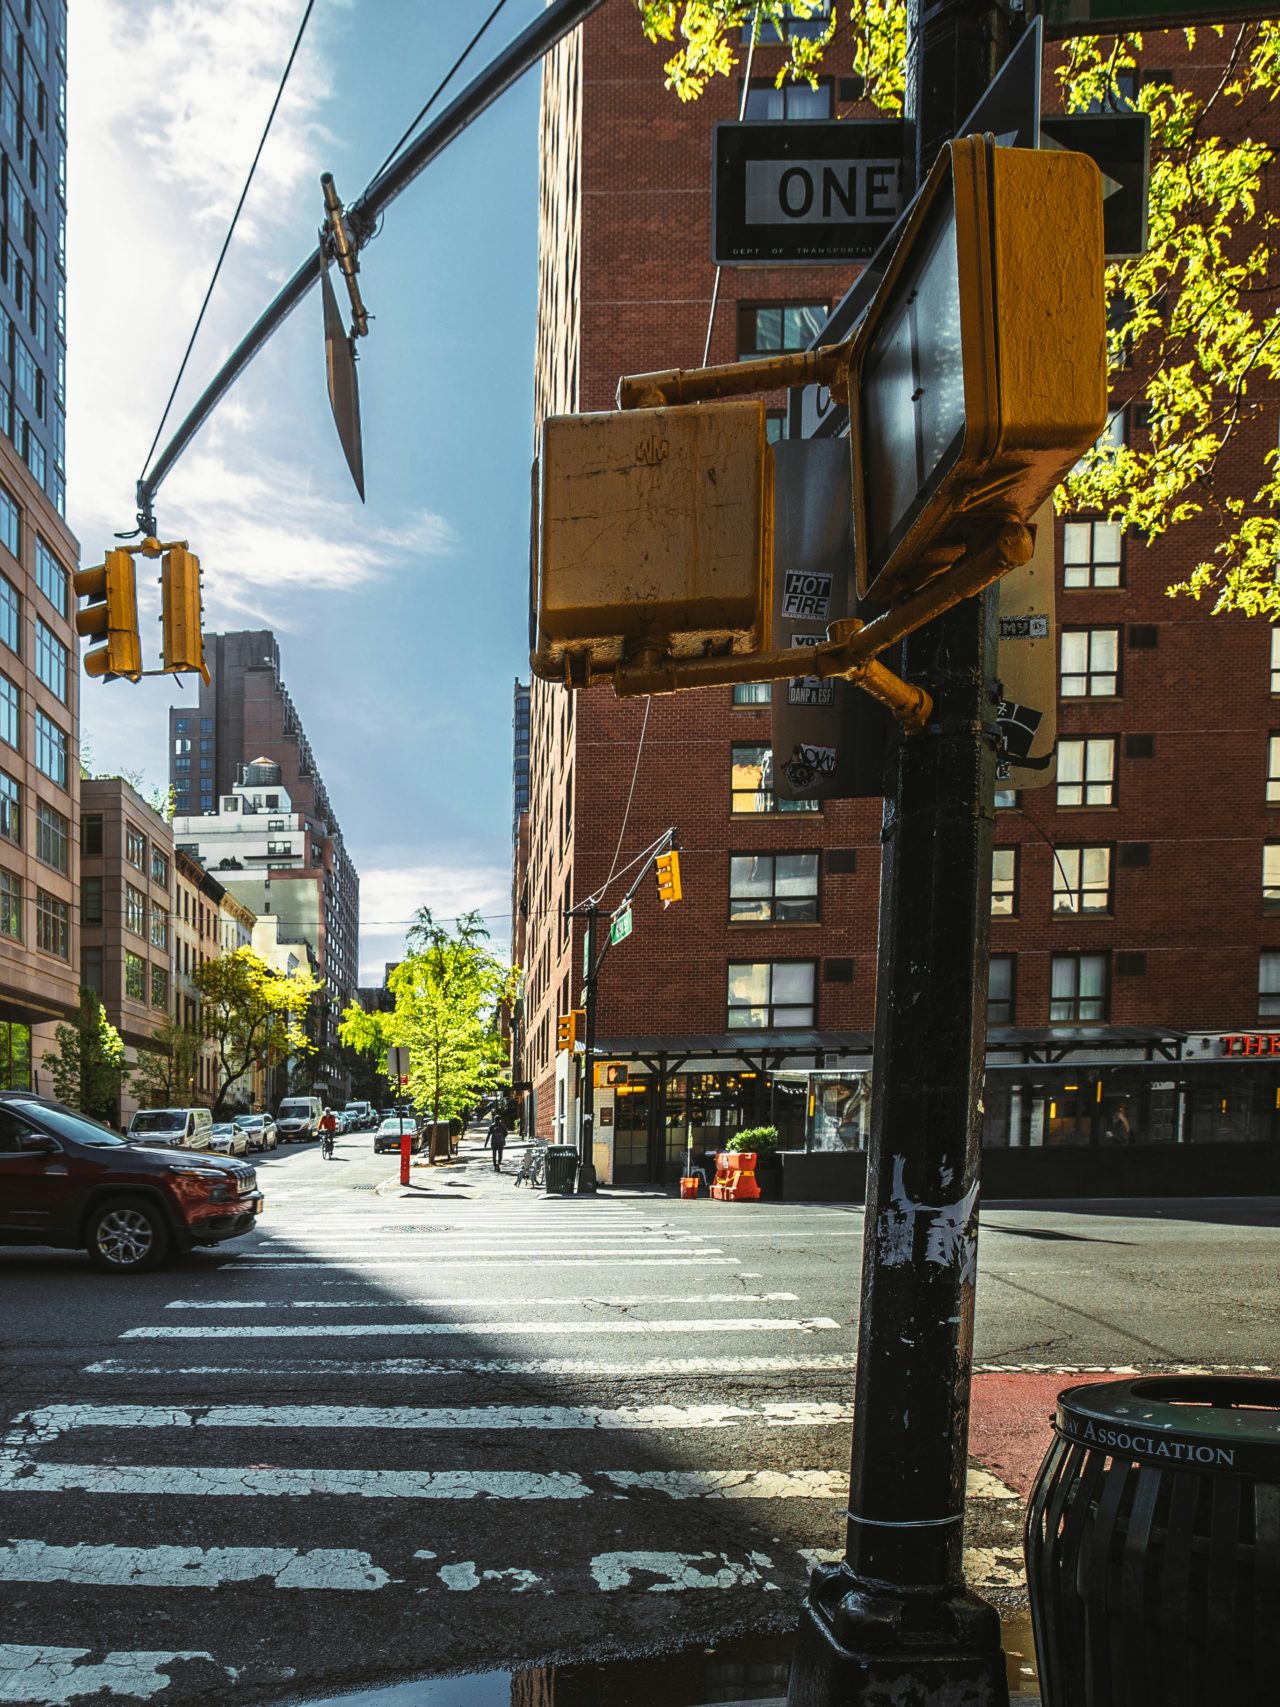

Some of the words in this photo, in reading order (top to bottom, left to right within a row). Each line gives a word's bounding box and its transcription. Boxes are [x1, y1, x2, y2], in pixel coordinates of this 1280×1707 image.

[778, 166, 897, 218] ONE
[732, 247, 761, 256] DEPT
[771, 247, 785, 255] OF
[788, 575, 830, 595] HOT
[785, 595, 827, 615] FIRE
[1084, 1420, 1236, 1466] ASSOCIATION
